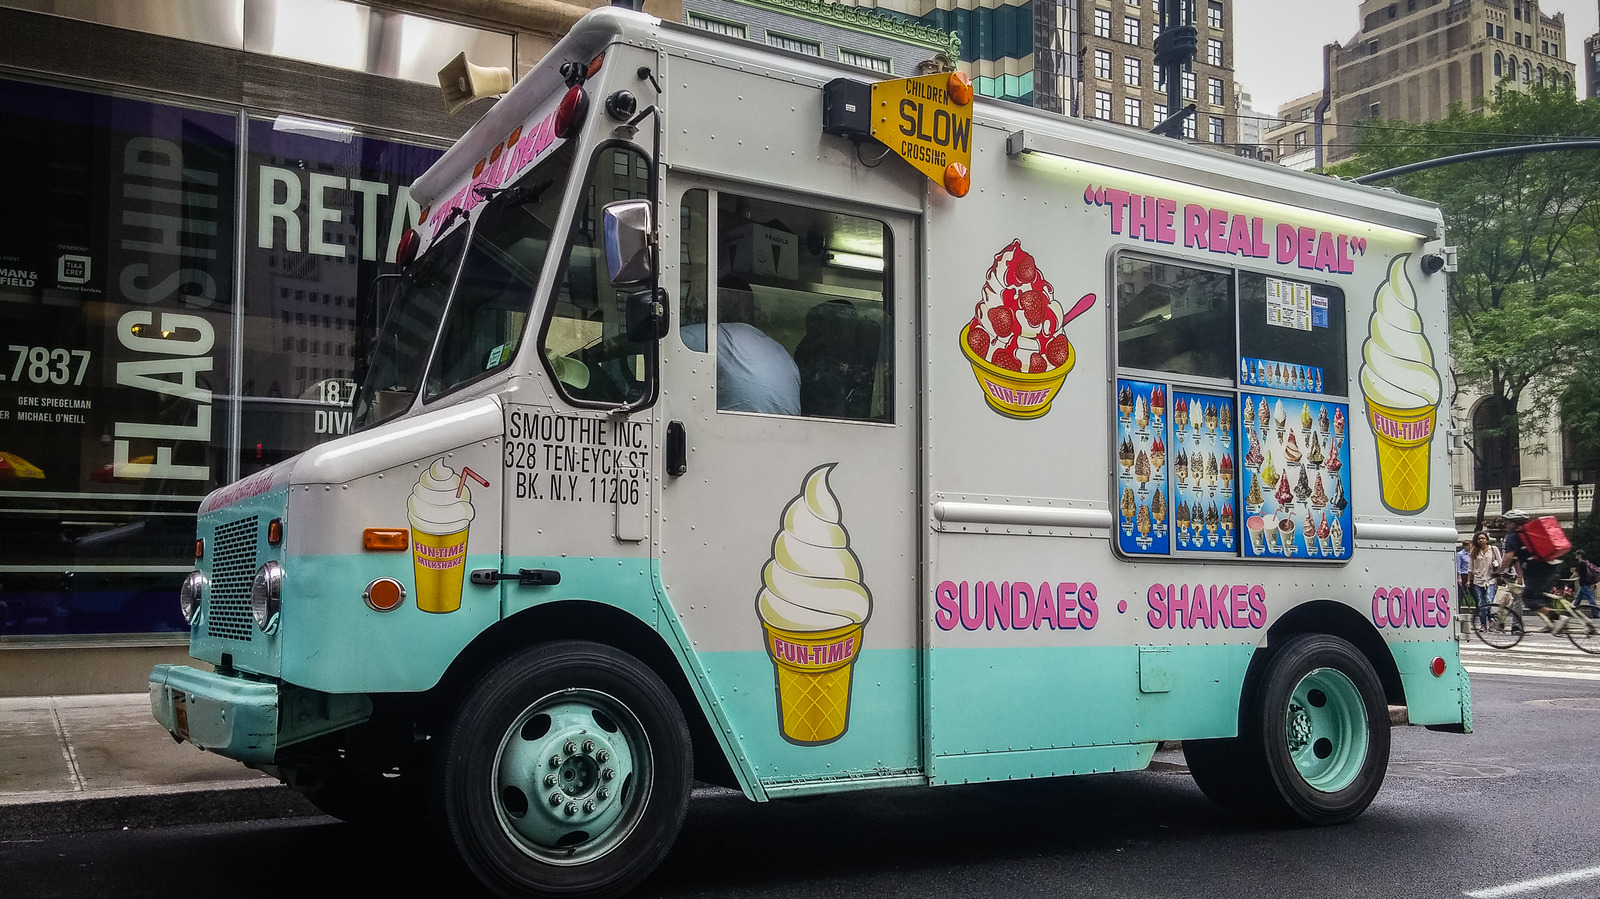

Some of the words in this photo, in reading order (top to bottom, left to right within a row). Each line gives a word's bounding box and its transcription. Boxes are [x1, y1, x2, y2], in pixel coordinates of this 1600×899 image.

[906, 79, 950, 105] CHILDREN
[899, 98, 971, 153] SLOW
[901, 141, 946, 167] CROSSING
[1184, 204, 1270, 258] REAL
[29, 271, 38, 280] &
[113, 136, 219, 480] FLAGSHIP
[18, 396, 39, 406] GENE
[41, 397, 92, 409] SPIEGELMAN
[984, 378, 1052, 406] FUN-TIME
[18, 411, 53, 422] MICHAEL
[55, 413, 86, 424] O'NEILL
[510, 412, 607, 446] SMOOTHIE
[613, 421, 648, 449] INC.
[1373, 411, 1431, 441] FUN-TIME
[505, 441, 536, 469] 328
[543, 444, 623, 475] TEN-EYCK
[516, 472, 543, 499] BK.
[550, 474, 582, 502] N.Y.
[590, 476, 639, 505] 11206
[414, 541, 465, 558] FUN-TIME
[417, 555, 464, 570] MILKSHAKE
[935, 580, 1100, 630] SUNDAES
[1147, 583, 1267, 629] SHAKES
[1372, 587, 1450, 630] CONES
[774, 637, 855, 665] FUN-TIME
